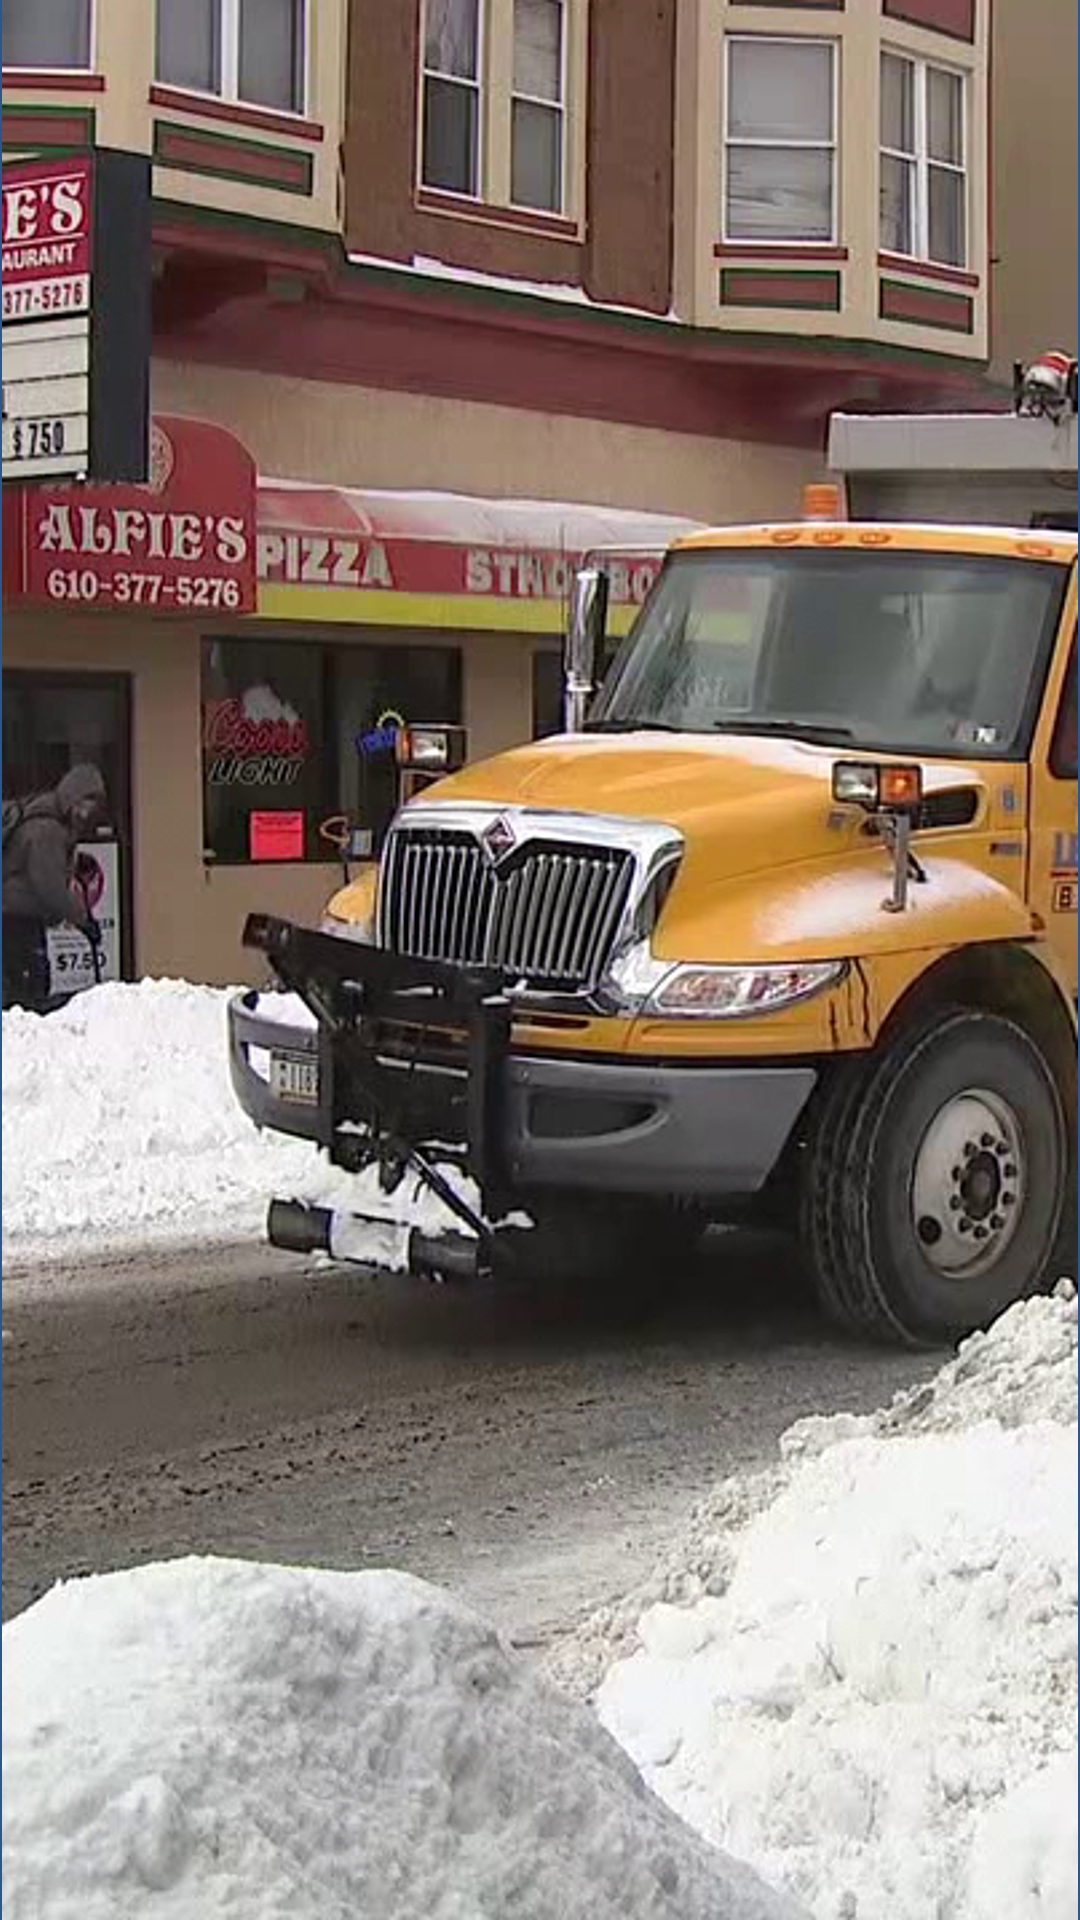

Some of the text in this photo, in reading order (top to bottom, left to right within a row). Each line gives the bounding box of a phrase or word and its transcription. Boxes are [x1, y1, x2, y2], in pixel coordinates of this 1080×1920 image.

[39, 504, 246, 563] ALFIE'S
[48, 569, 240, 607] 610-377-5276
[256, 534, 657, 604] PIZZA STROBO
